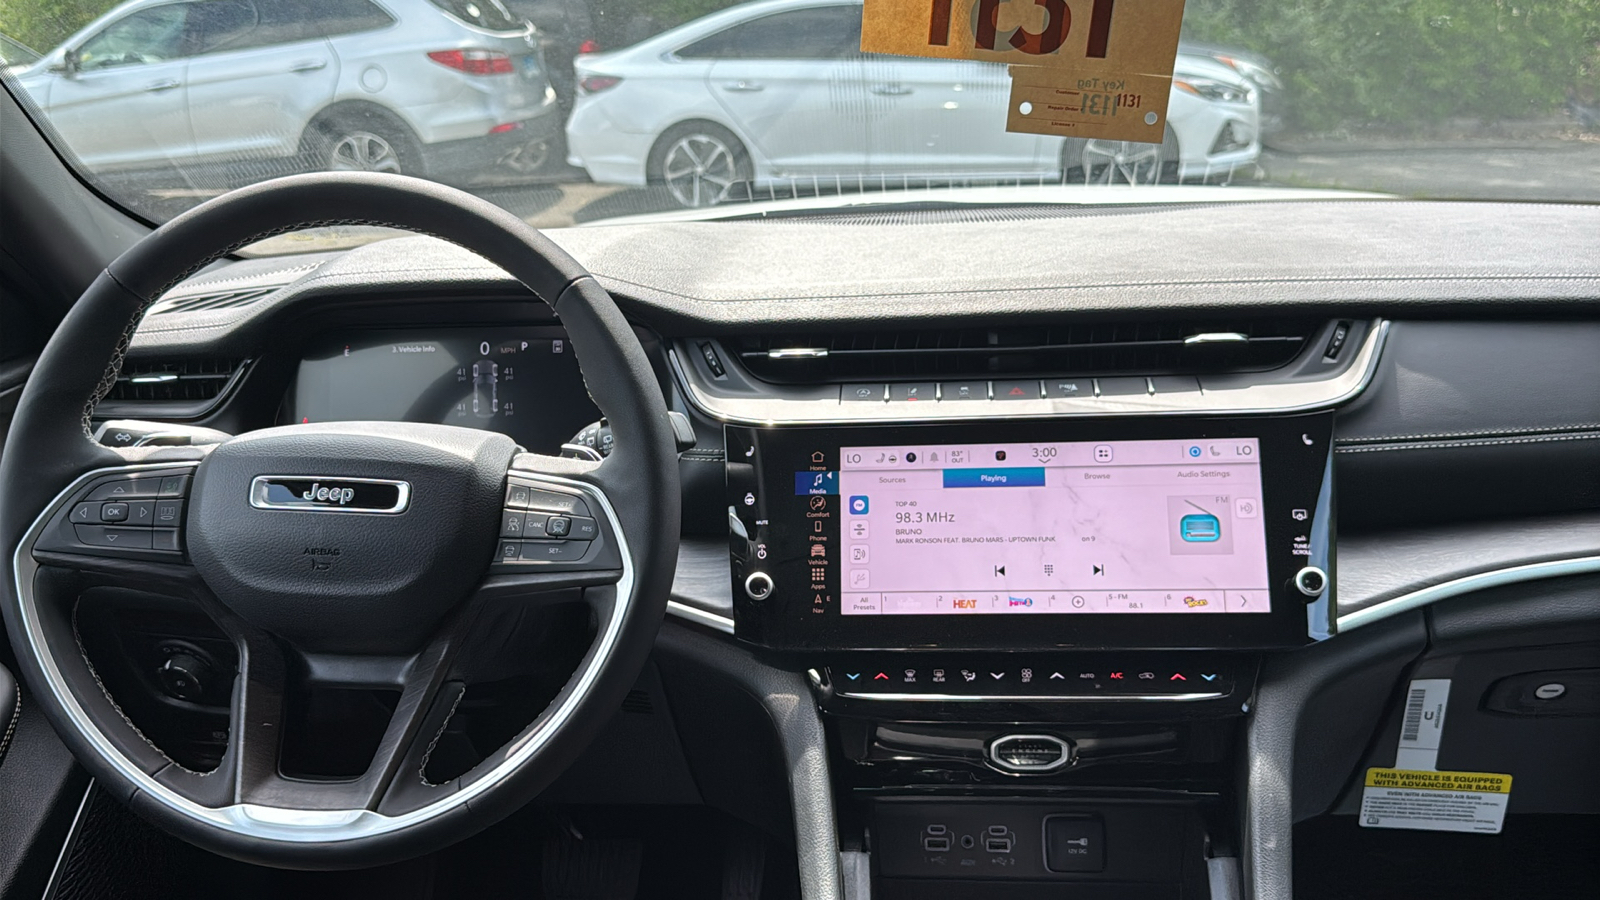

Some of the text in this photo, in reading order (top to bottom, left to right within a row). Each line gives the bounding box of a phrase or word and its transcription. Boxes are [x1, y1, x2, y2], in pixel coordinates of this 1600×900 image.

[1116, 93, 1142, 108] 1131
[399, 345, 422, 354] Vehicle
[423, 345, 436, 353] Info
[500, 346, 516, 354] MPH
[521, 341, 528, 351] P
[457, 368, 466, 376] 41
[504, 367, 514, 375] 41
[457, 403, 466, 411] 41
[504, 402, 514, 410] 41
[1032, 447, 1057, 458] 3:00
[1236, 445, 1253, 456] LO
[846, 453, 862, 463] LO
[980, 474, 1007, 483] Playing
[1084, 472, 1111, 480] Browse
[1177, 470, 1230, 479] Audio Settings
[878, 476, 906, 484] Sources
[303, 483, 355, 505] Jeep
[1215, 496, 1229, 504] FM
[107, 508, 120, 516] OK
[895, 511, 956, 524] 98.3 MHz
[895, 528, 922, 536] BRUNO
[303, 548, 341, 556] AIRBAG
[953, 599, 977, 609] HEAT
[1399, 773, 1440, 781] VEHICLE
[1454, 776, 1503, 785] EQUIPPED
[1401, 781, 1454, 789] ADVANCED
[1476, 784, 1502, 792] BAGS
